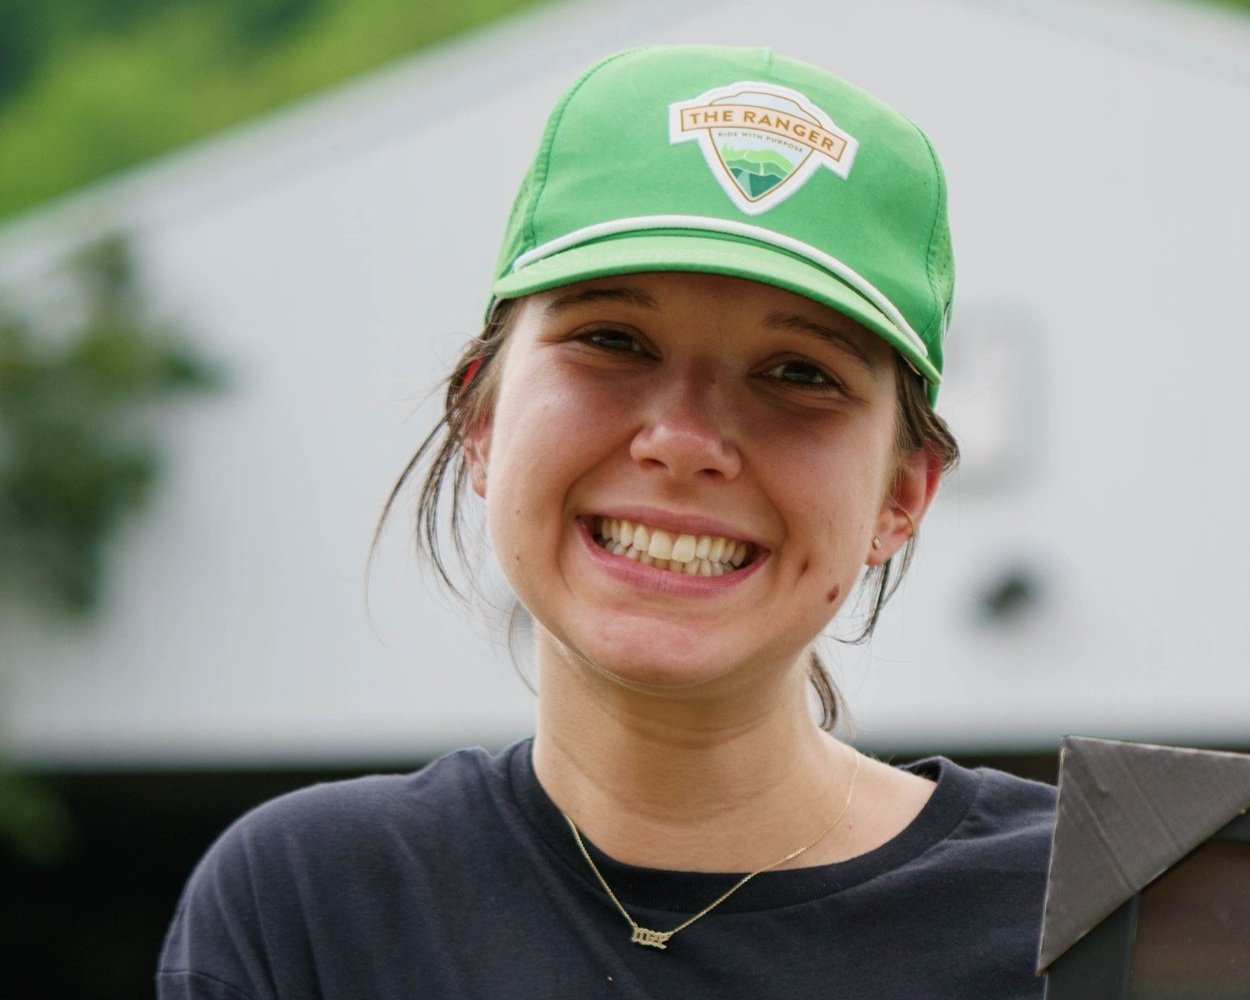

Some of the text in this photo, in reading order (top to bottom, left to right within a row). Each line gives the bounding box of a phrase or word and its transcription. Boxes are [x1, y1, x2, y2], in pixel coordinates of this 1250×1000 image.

[690, 110, 834, 151] THE RANGER
[741, 132, 763, 140] WITH
